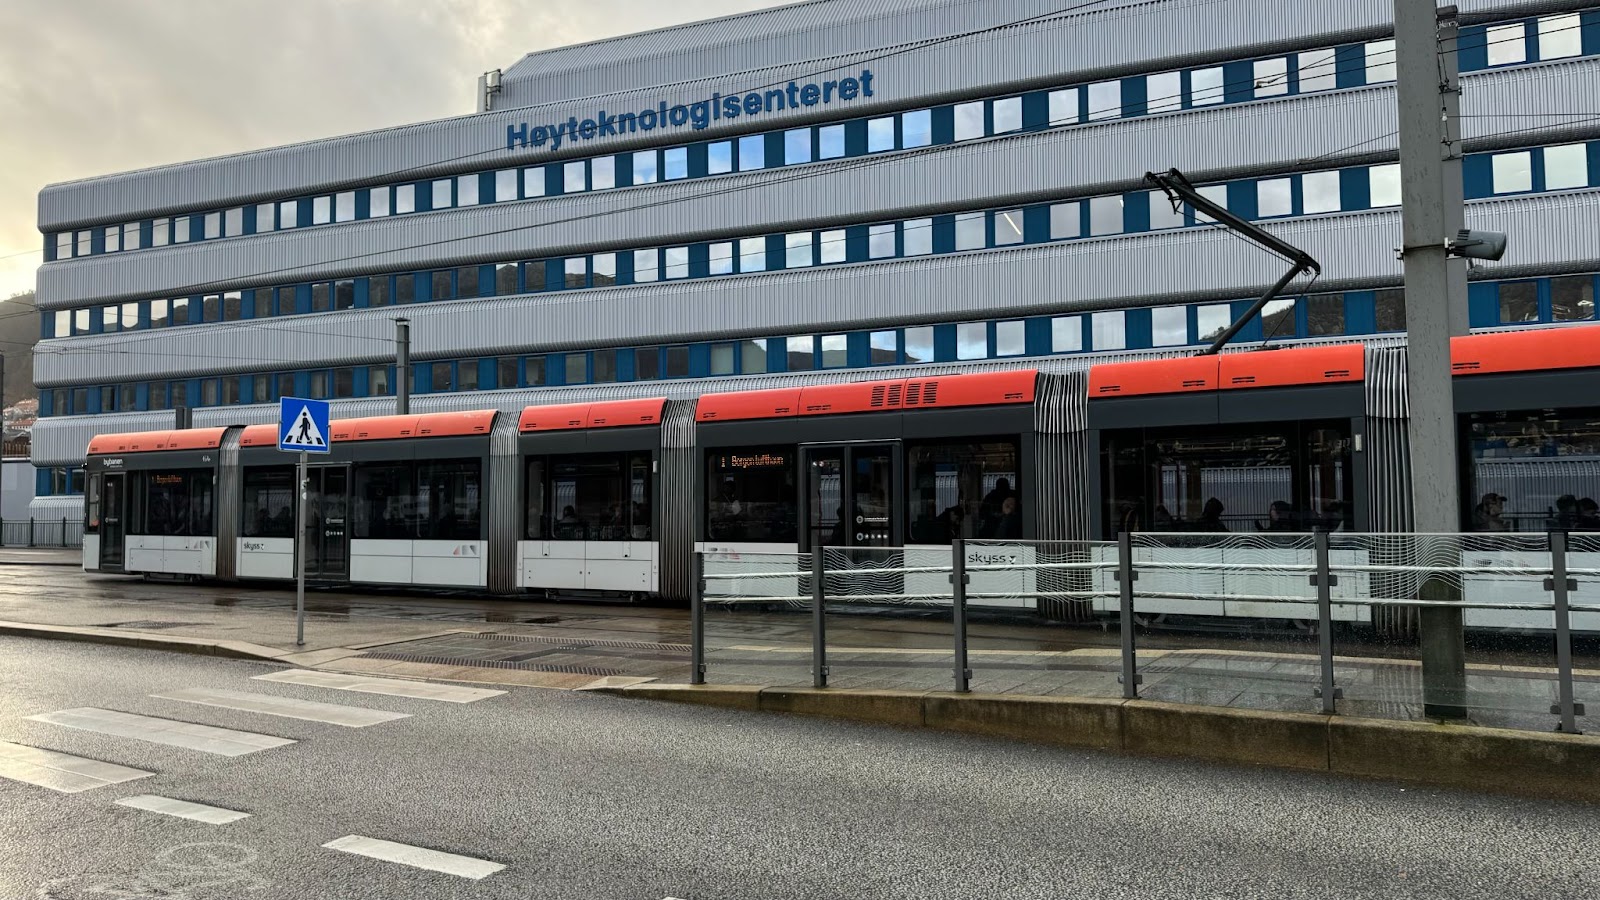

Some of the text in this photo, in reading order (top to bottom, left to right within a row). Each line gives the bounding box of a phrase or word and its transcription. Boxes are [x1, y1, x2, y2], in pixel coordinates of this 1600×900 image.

[506, 69, 874, 151] Høyteknologisenteret
[243, 541, 260, 551] skyss
[968, 552, 1006, 566] skyss
